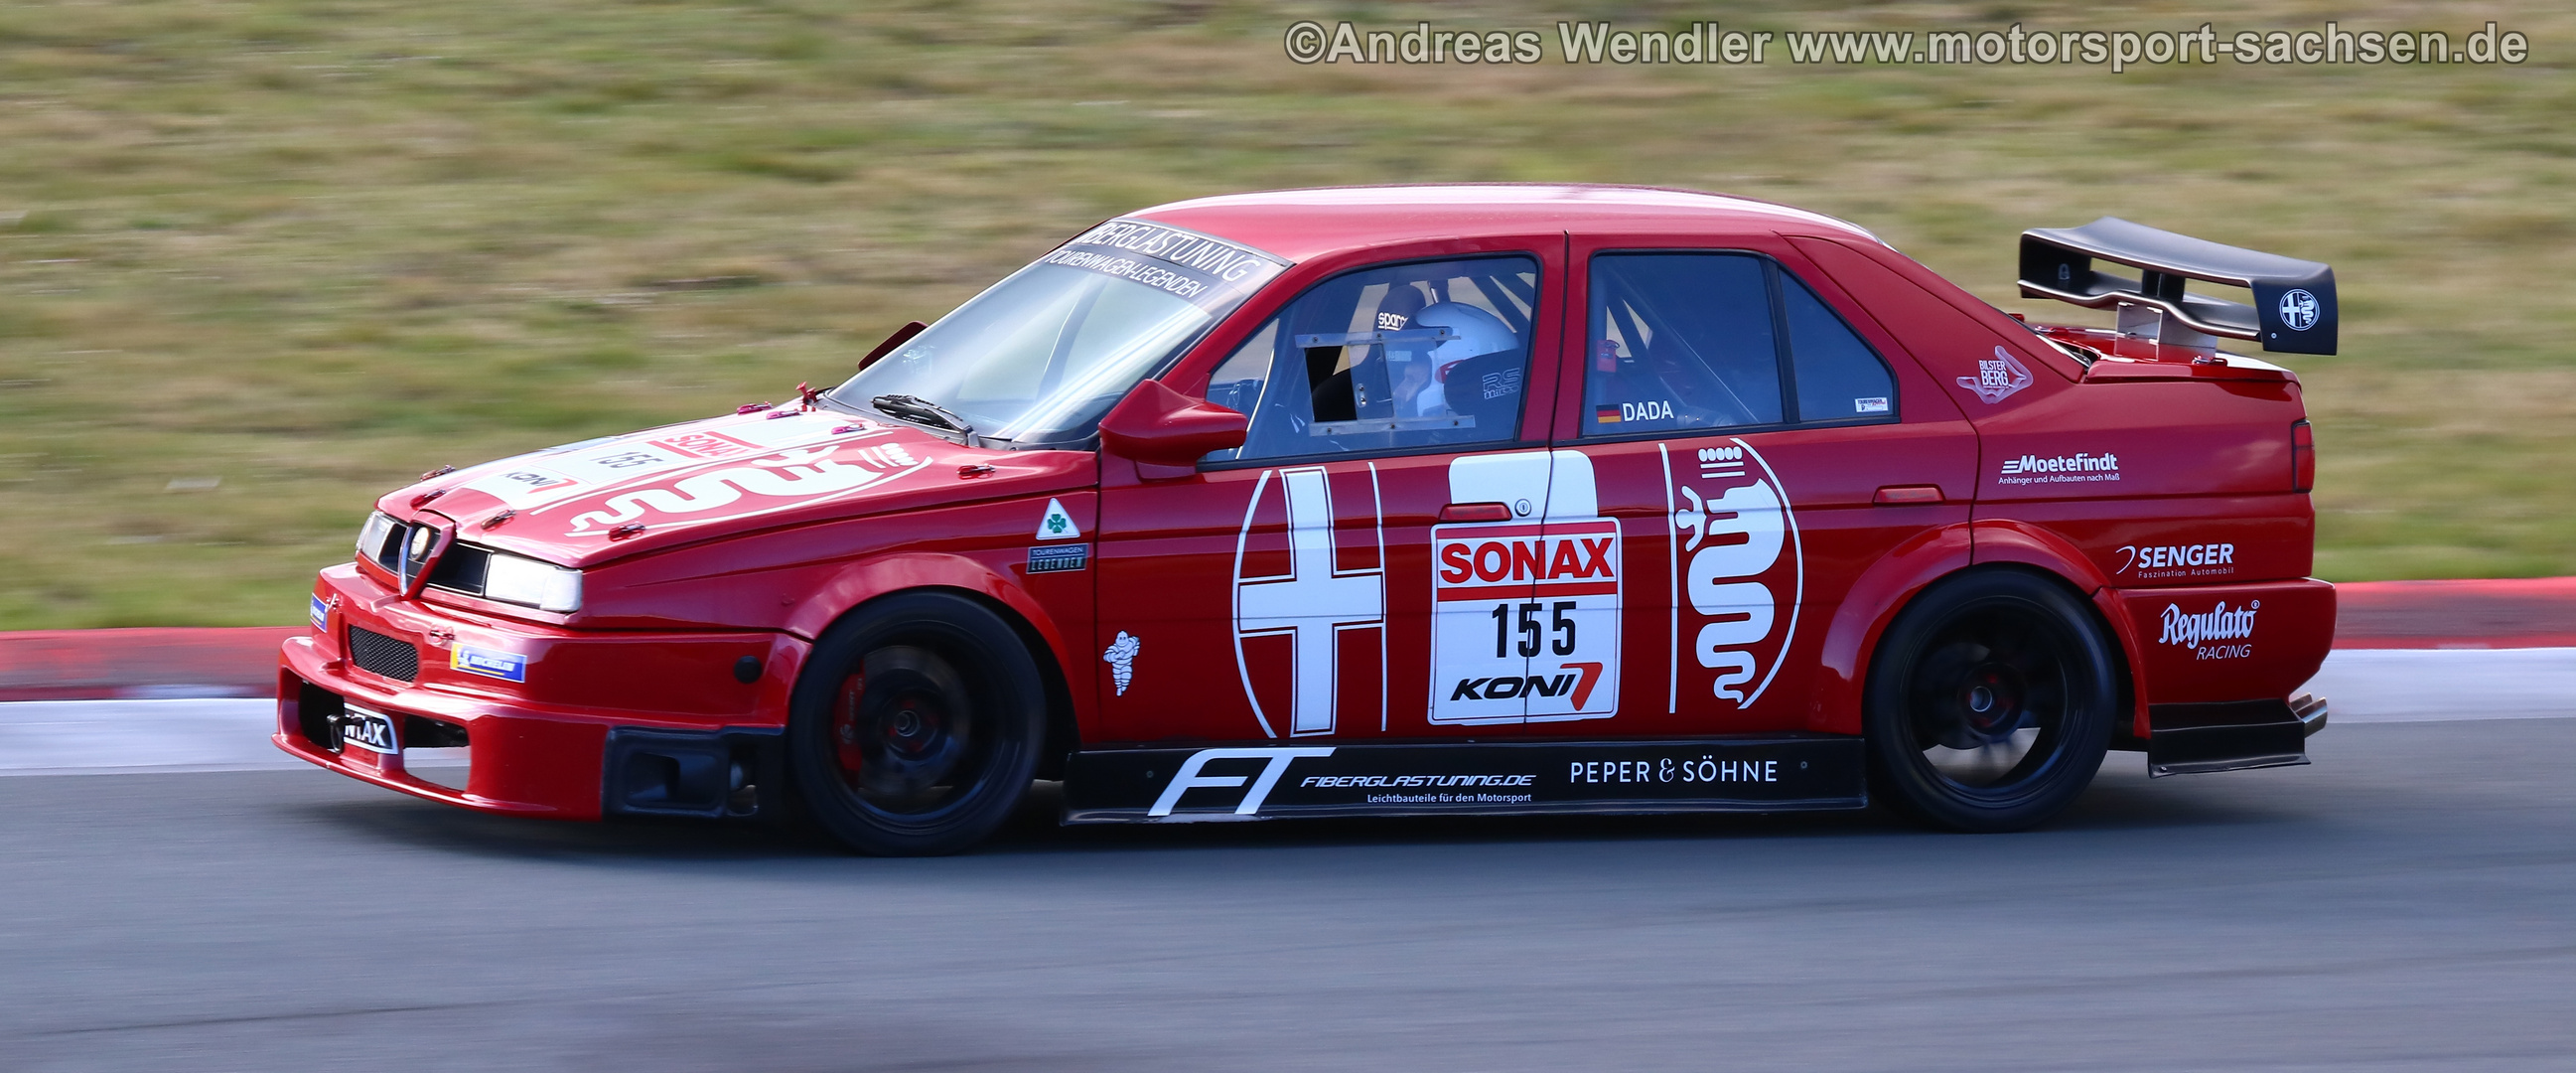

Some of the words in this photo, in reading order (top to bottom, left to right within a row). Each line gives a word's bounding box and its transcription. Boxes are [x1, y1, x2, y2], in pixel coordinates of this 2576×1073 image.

[1978, 360, 2006, 371] BILSTER
[1483, 368, 1520, 391] RS
[1981, 371, 2009, 386] BERG
[1622, 400, 1674, 422] DADA
[589, 451, 664, 469] 155
[2001, 452, 2119, 474] Moetefindt
[1998, 477, 2033, 486] Anhänger
[2050, 474, 2086, 483] Aufbauten
[2087, 473, 2103, 482] nach
[1033, 546, 1083, 556] TOURENWAGEN
[2137, 543, 2234, 569] SENGER
[1031, 556, 1082, 571] LEGENDEN
[1440, 537, 1615, 584] SONAX
[2138, 569, 2187, 578] Faszination
[2191, 566, 2234, 576] Automobil
[1492, 601, 1577, 658] 155
[2196, 644, 2252, 661] RACING
[1450, 675, 1577, 701] KONI
[1570, 761, 1649, 783] PEPER
[1658, 758, 1675, 783] &
[1683, 754, 1778, 783] SÖHNE
[1147, 747, 1337, 817] FT
[1300, 775, 1536, 788] FIBERGLASTUNING.DE
[1366, 794, 1437, 803] Leichtbauteile
[1439, 793, 1453, 803] für
[1456, 793, 1475, 803] den
[1477, 793, 1532, 804] Motorsport
